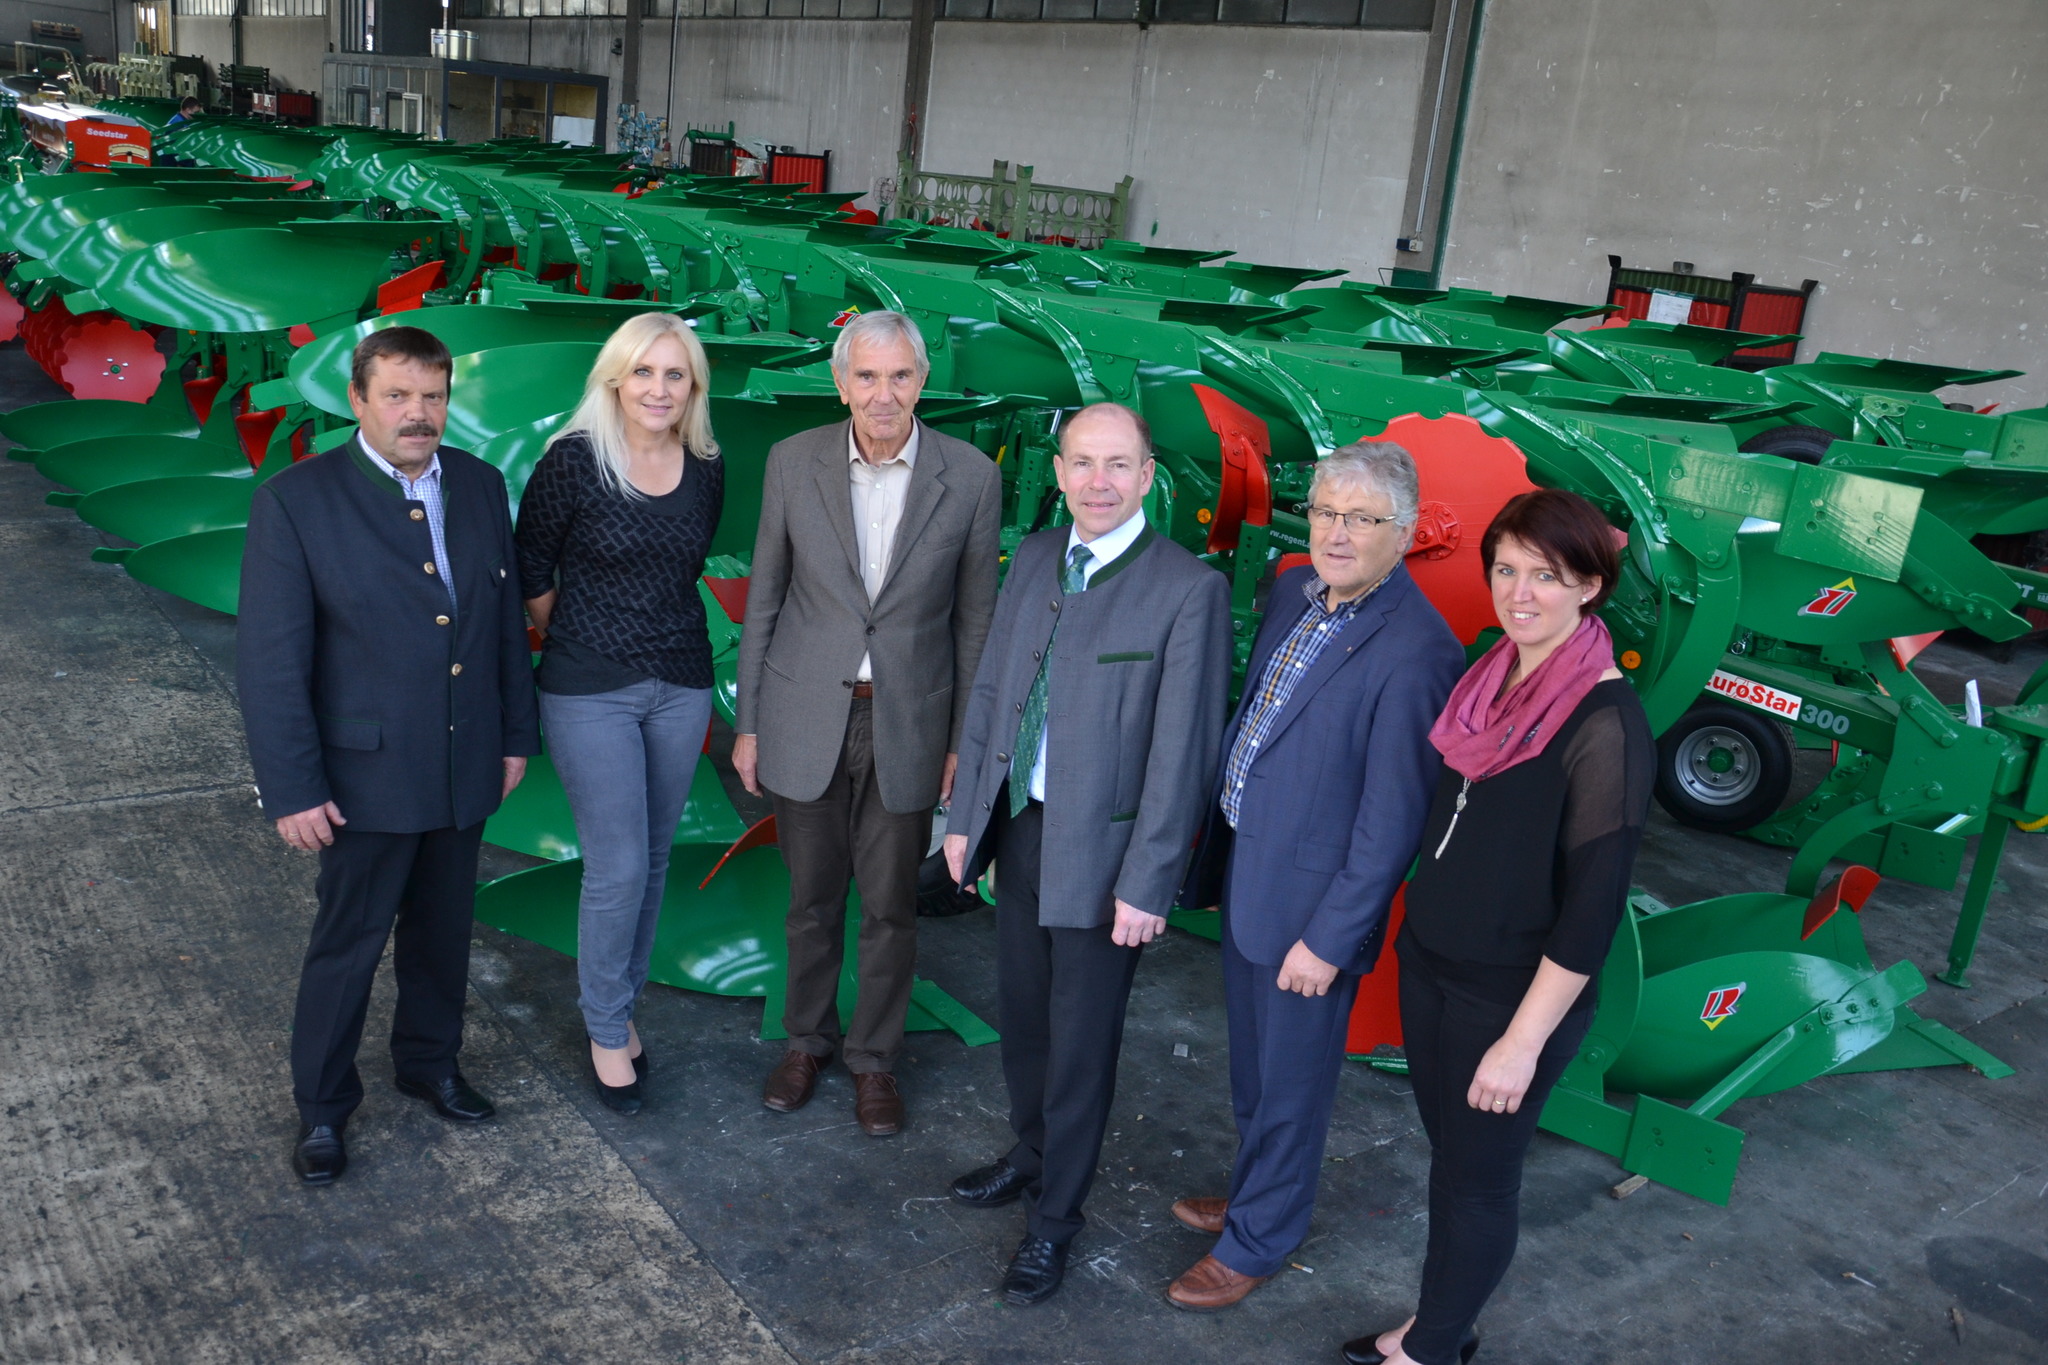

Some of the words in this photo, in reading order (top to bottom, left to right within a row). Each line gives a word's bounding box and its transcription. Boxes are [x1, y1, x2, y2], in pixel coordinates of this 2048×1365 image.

[86, 127, 128, 139] Seedstar
[1705, 675, 1799, 715] uroStar
[1801, 704, 1850, 735] 300
